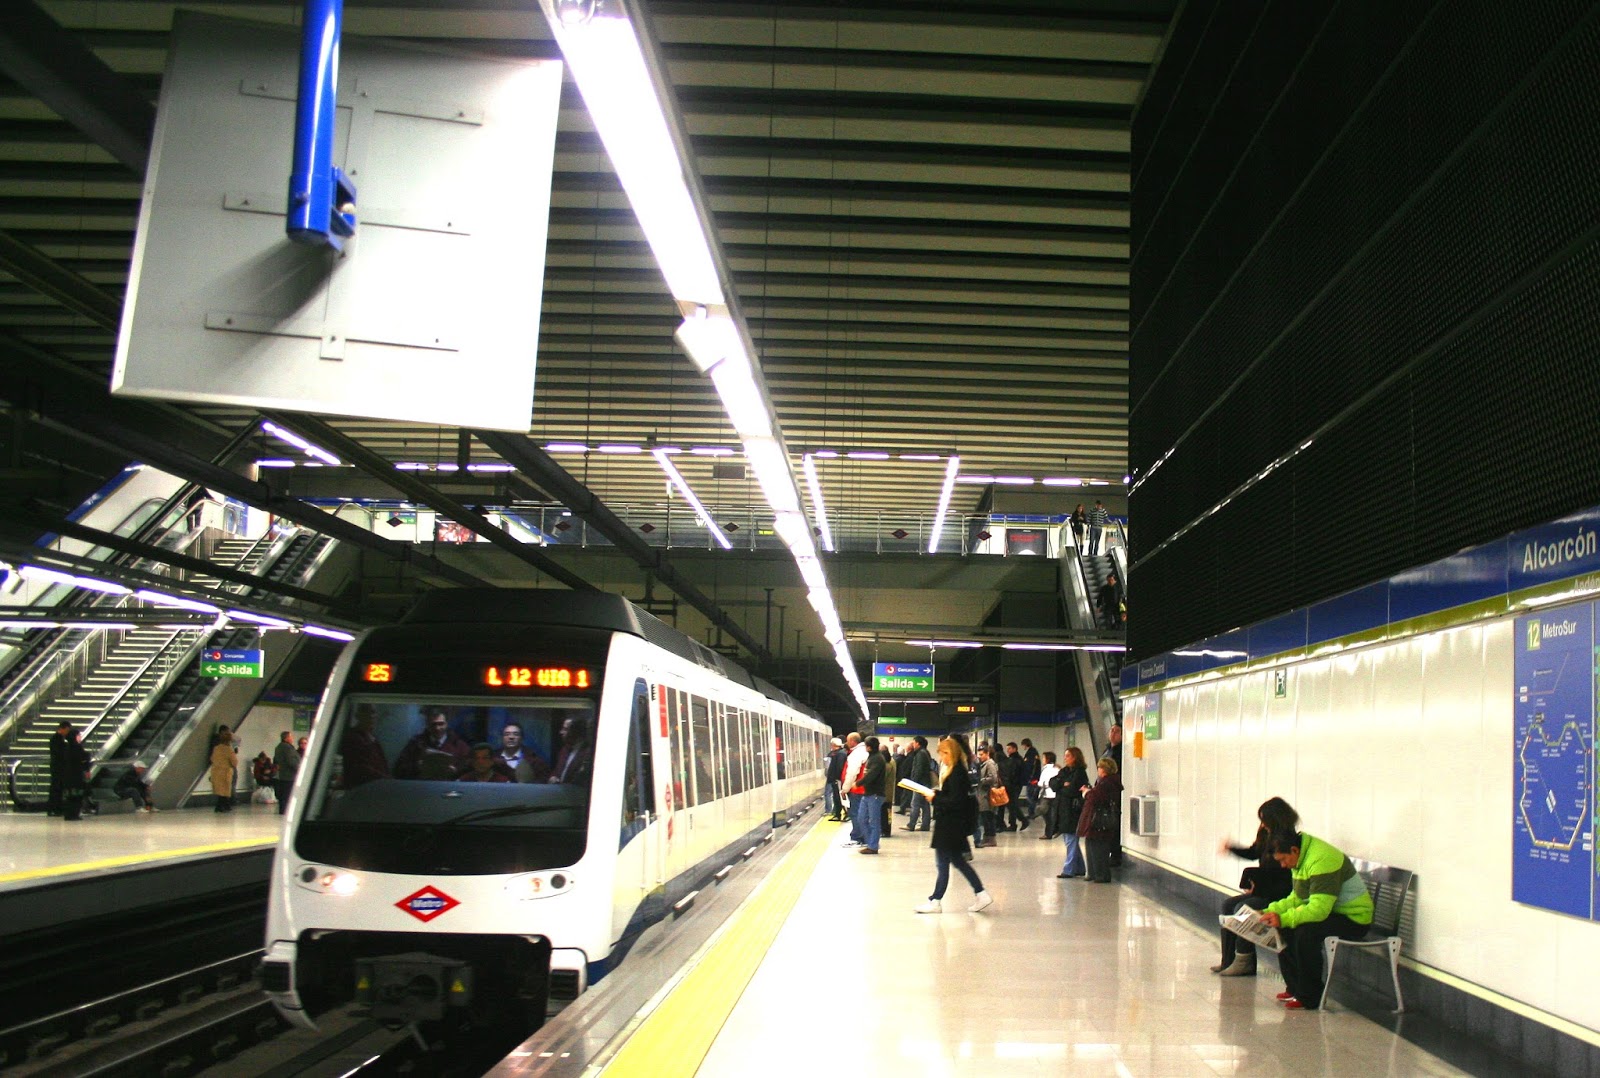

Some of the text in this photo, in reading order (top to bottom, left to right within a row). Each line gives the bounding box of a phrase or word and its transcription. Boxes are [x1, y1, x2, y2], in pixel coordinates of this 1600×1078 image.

[1523, 526, 1596, 572] Alcorcón
[1528, 620, 1576, 649] 12 MetroSur
[218, 664, 253, 675] Salida
[369, 664, 390, 682] 25
[488, 667, 502, 685] L
[508, 668, 531, 686] 12
[576, 670, 588, 687] 1
[880, 678, 914, 688] Salida
[411, 899, 443, 908] Metro
